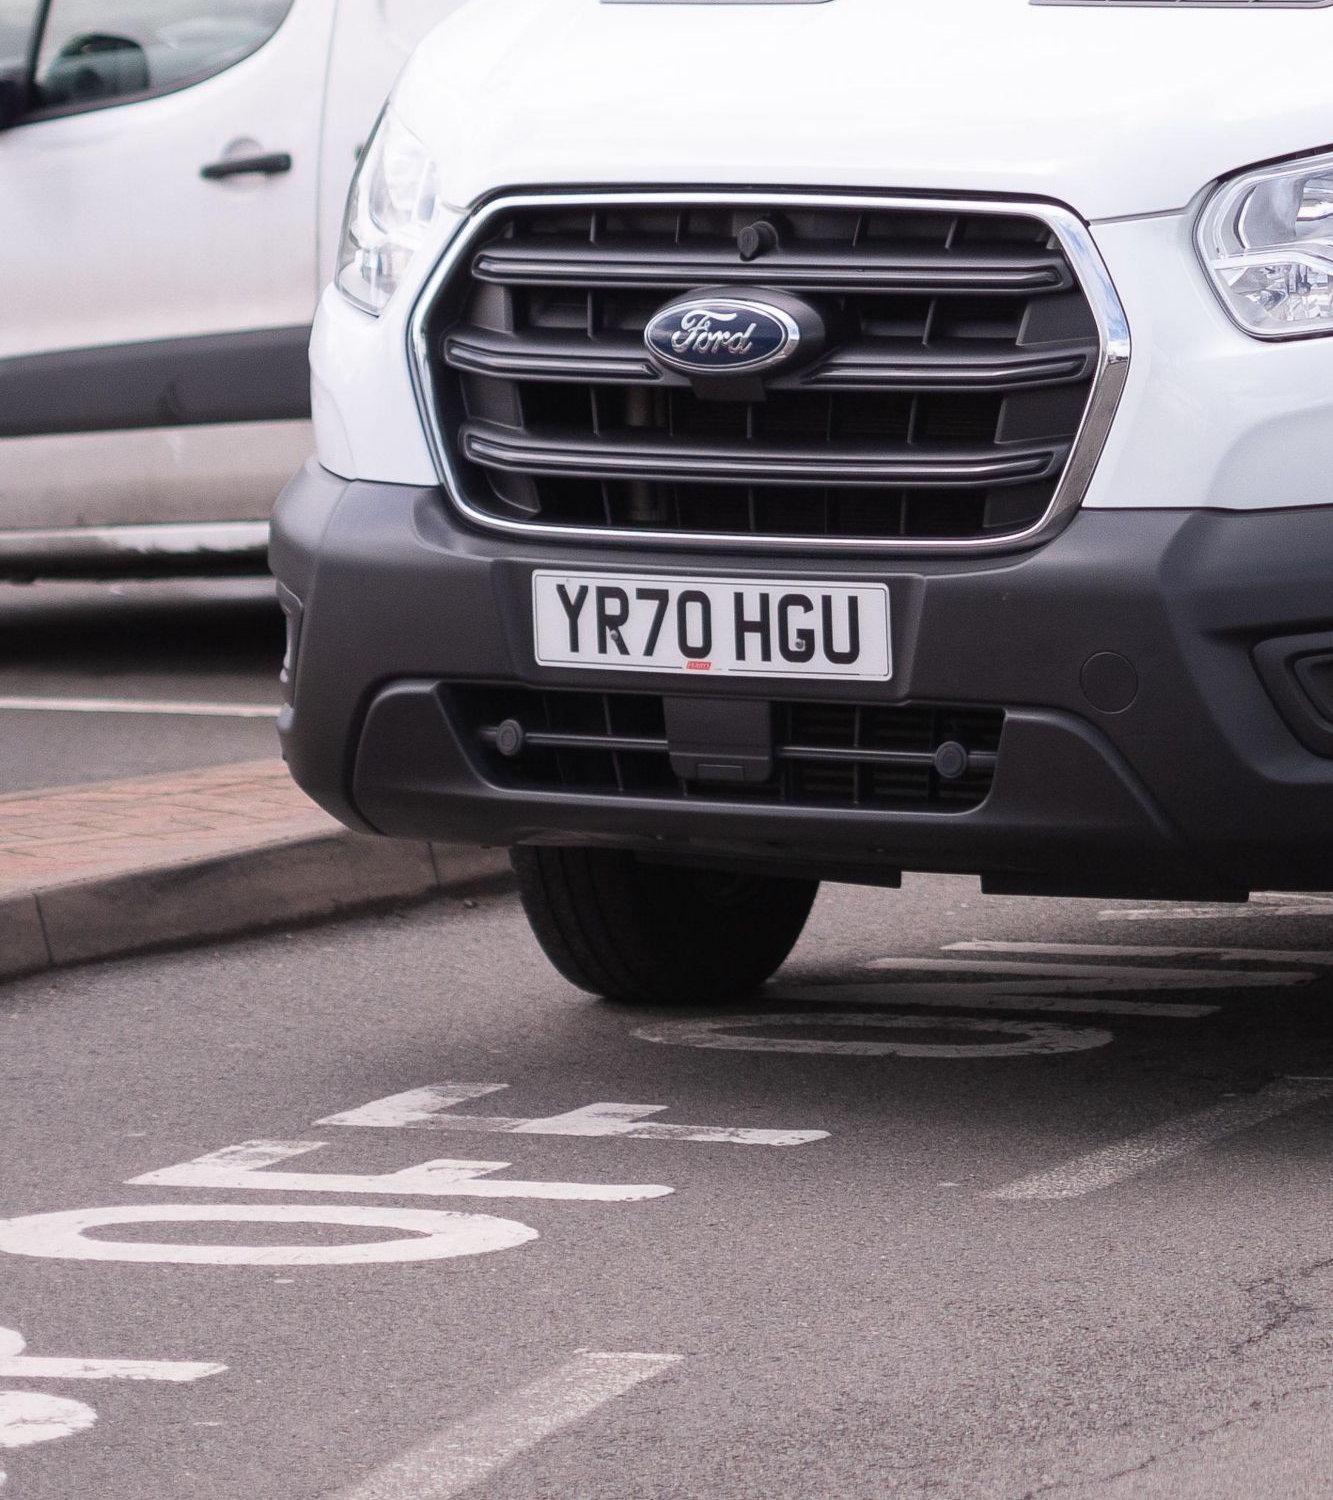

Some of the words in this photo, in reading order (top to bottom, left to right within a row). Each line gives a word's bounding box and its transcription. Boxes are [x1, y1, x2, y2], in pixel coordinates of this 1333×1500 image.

[670, 308, 757, 356] Ford
[555, 583, 713, 660] YR70
[734, 590, 861, 666] HGU
[0, 1082, 832, 1266] OFF
